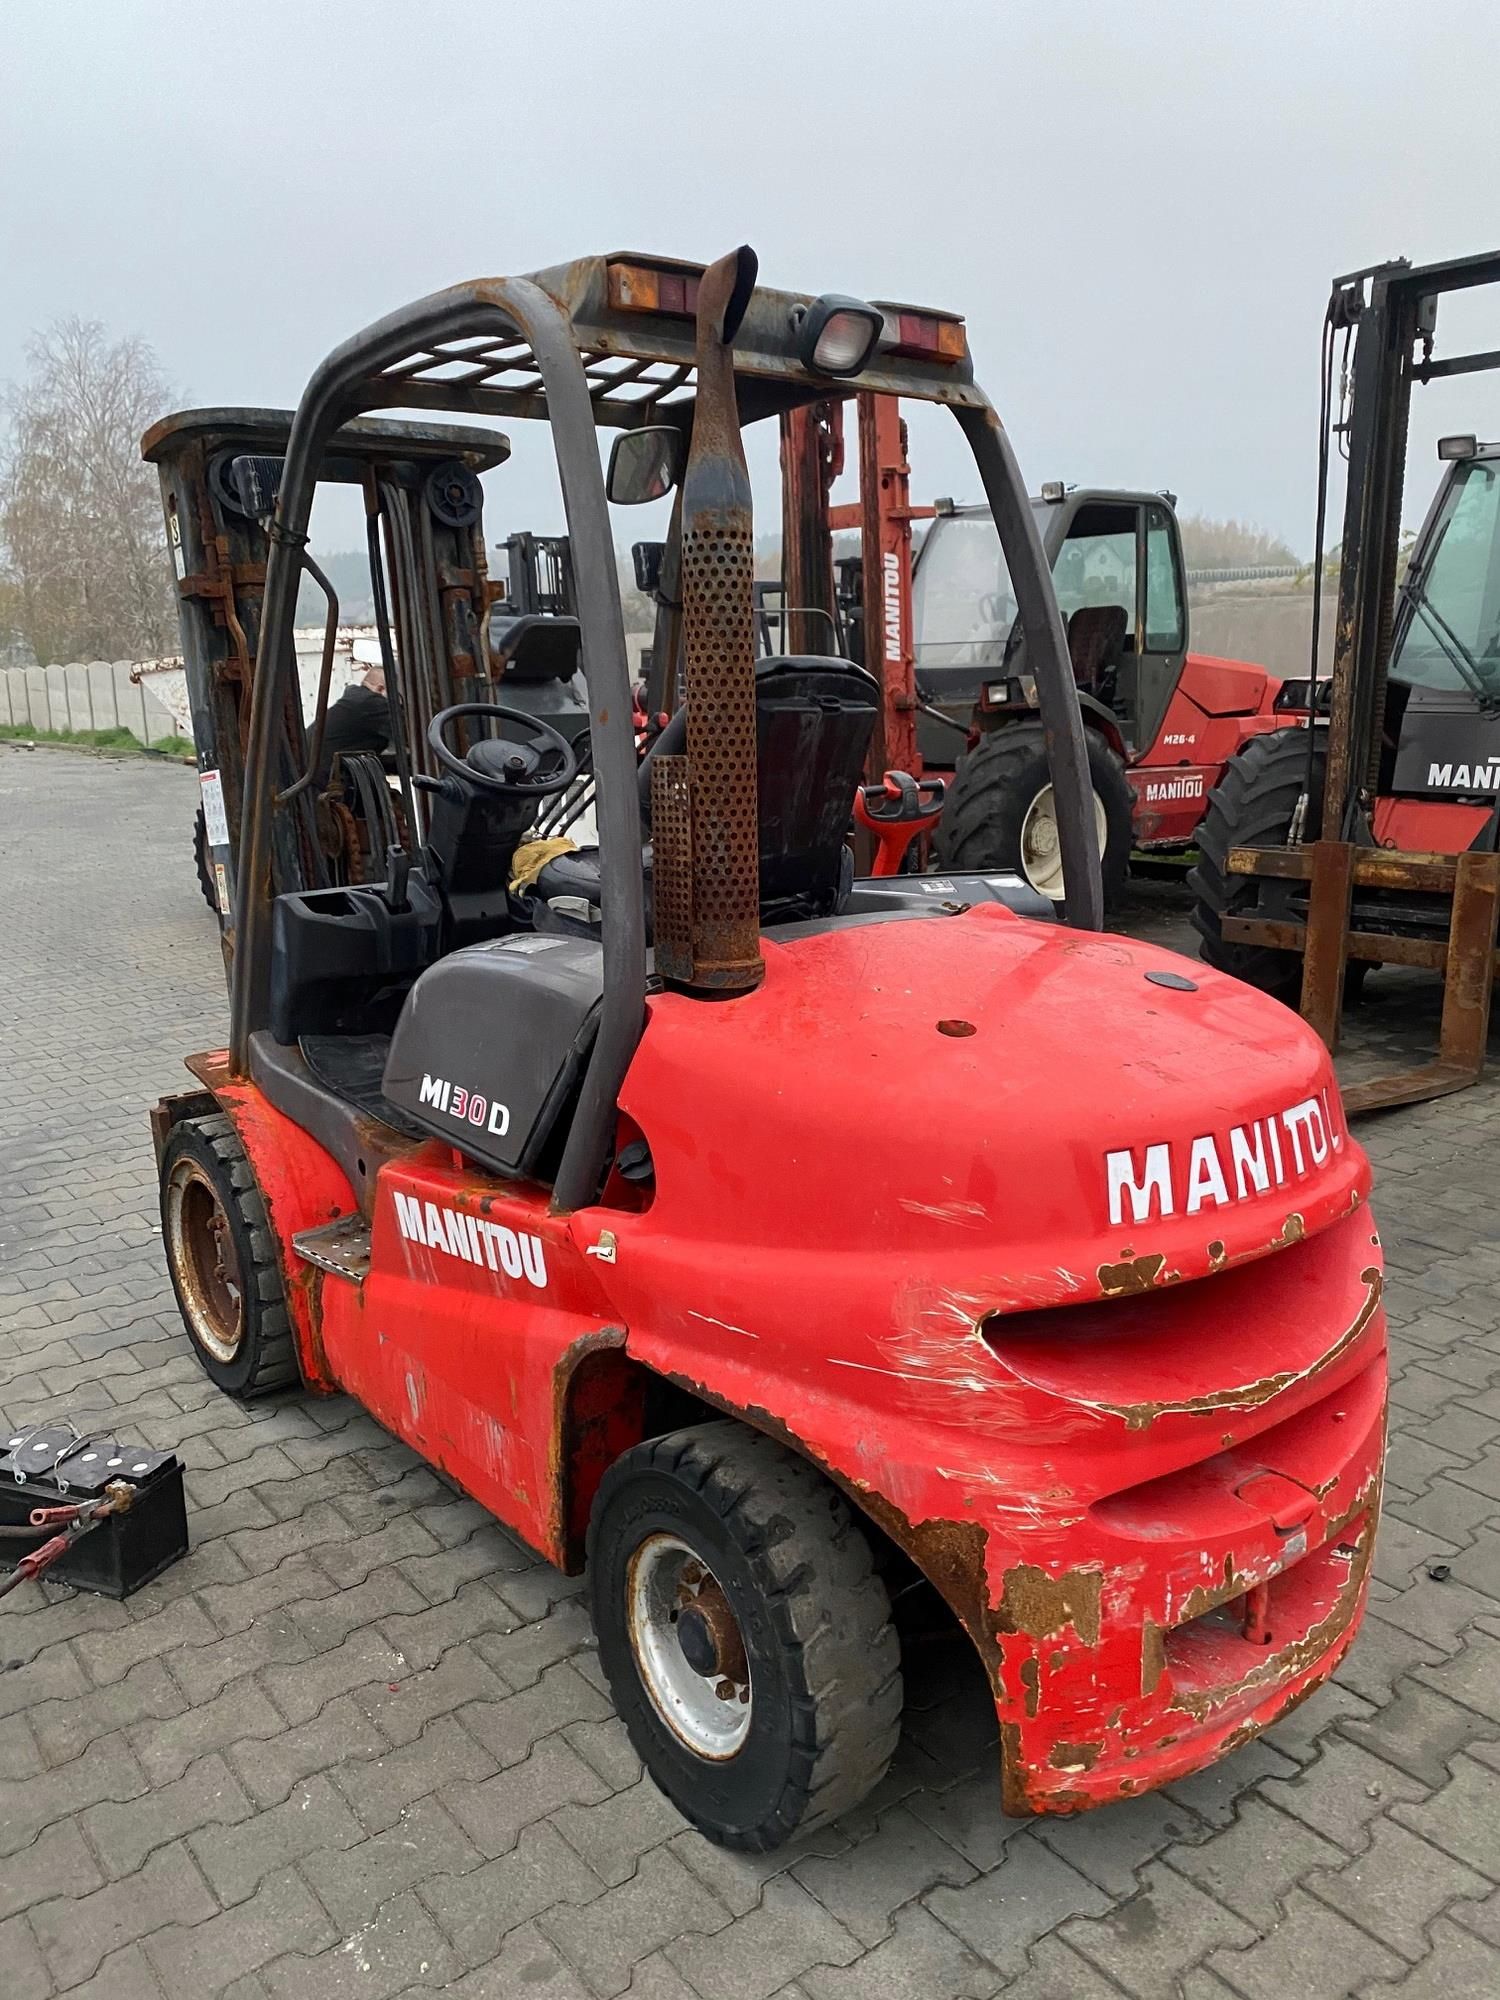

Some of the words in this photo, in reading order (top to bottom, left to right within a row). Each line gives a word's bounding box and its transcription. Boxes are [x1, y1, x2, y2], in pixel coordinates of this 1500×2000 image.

[884, 552, 901, 661] MANITOU
[1146, 774, 1204, 801] MANITOU
[393, 1191, 548, 1289] MANITOU
